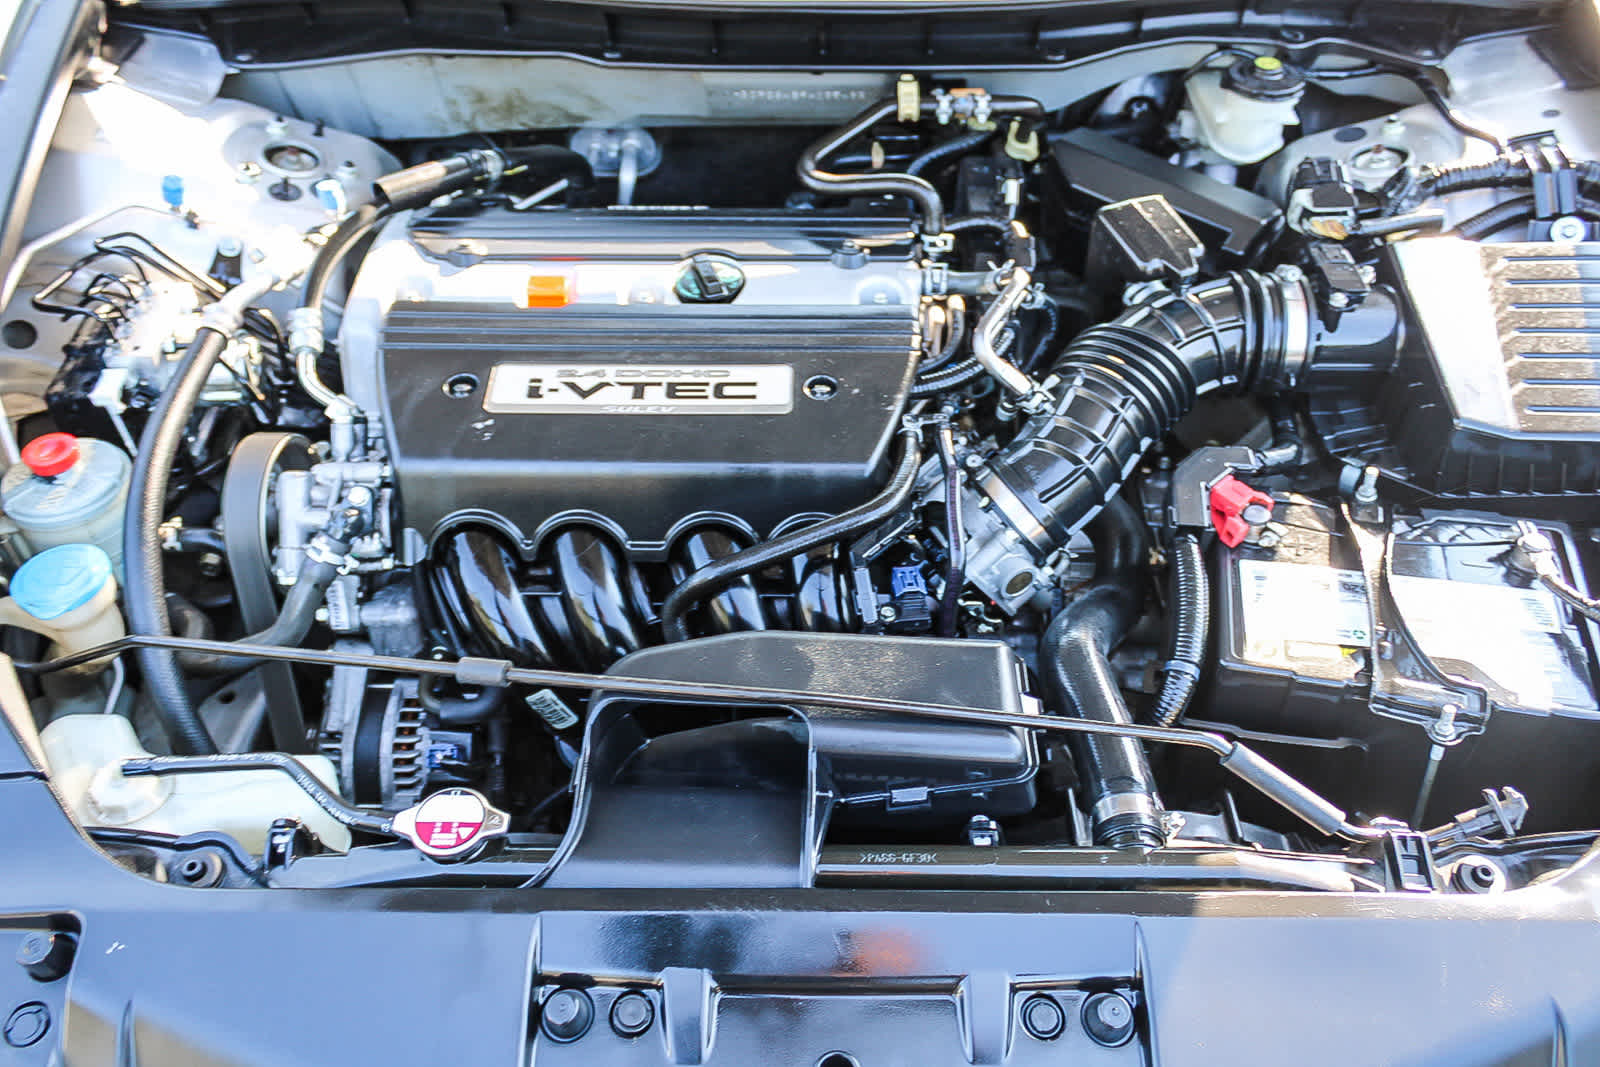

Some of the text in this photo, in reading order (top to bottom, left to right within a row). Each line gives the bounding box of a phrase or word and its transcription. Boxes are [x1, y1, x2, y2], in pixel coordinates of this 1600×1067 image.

[556, 369, 731, 378] 2.4 DOHC
[526, 378, 758, 400] i-VTEC
